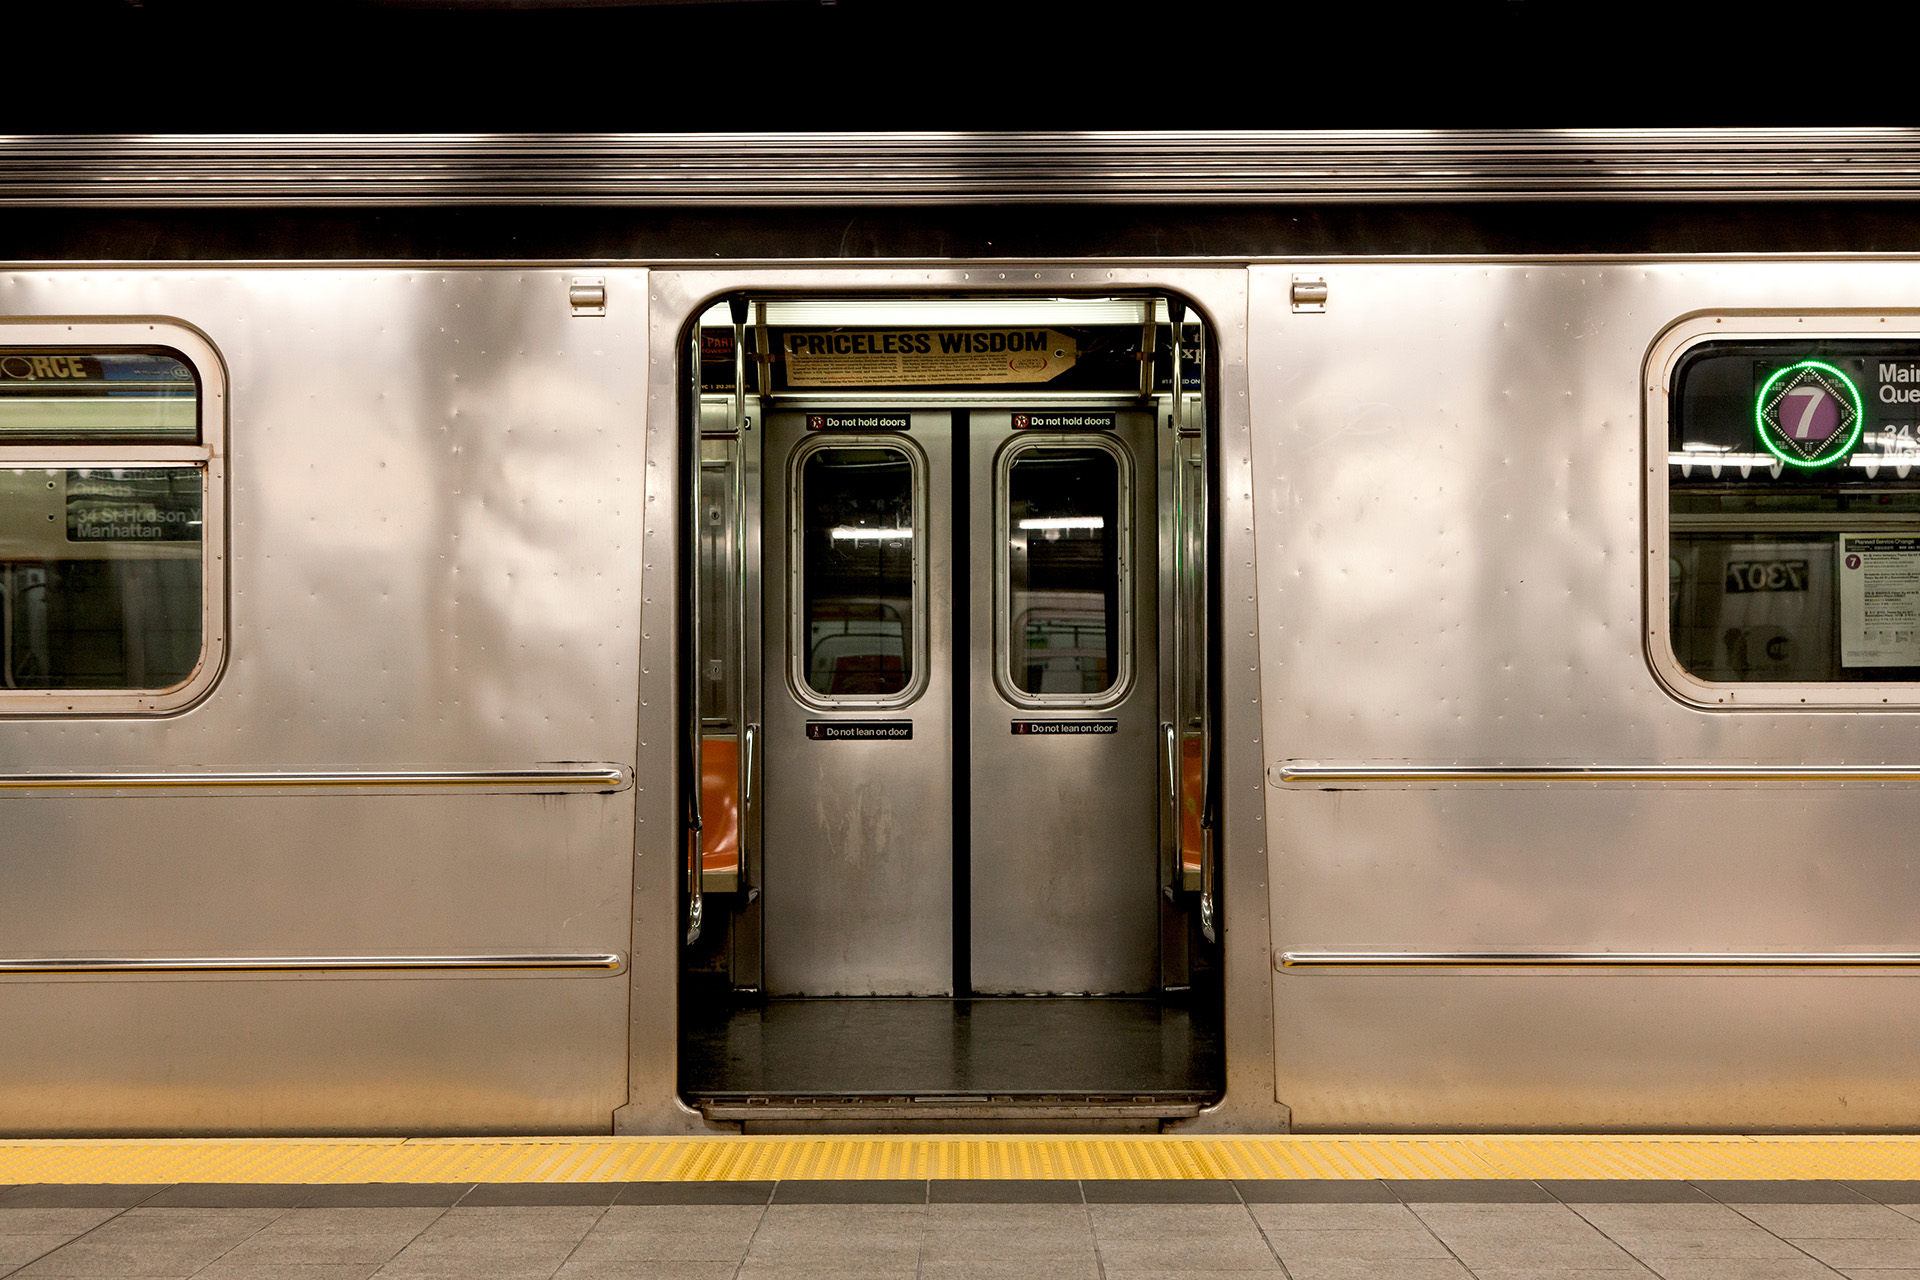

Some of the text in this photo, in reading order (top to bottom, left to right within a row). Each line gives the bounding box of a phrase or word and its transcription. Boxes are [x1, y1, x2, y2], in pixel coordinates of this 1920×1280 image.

[790, 332, 1047, 354] PRICELESS WISDOM
[1788, 386, 1826, 438] 7
[826, 418, 906, 427] Do not hold doors
[1031, 417, 1111, 426] Do not hold doors
[77, 508, 97, 523] 34
[102, 508, 186, 523] St-Hudson
[77, 523, 162, 538] Manhattan
[1850, 557, 1857, 567] 7
[826, 728, 908, 737] Do not lean on door
[1031, 724, 1113, 733] Do not lean on door
